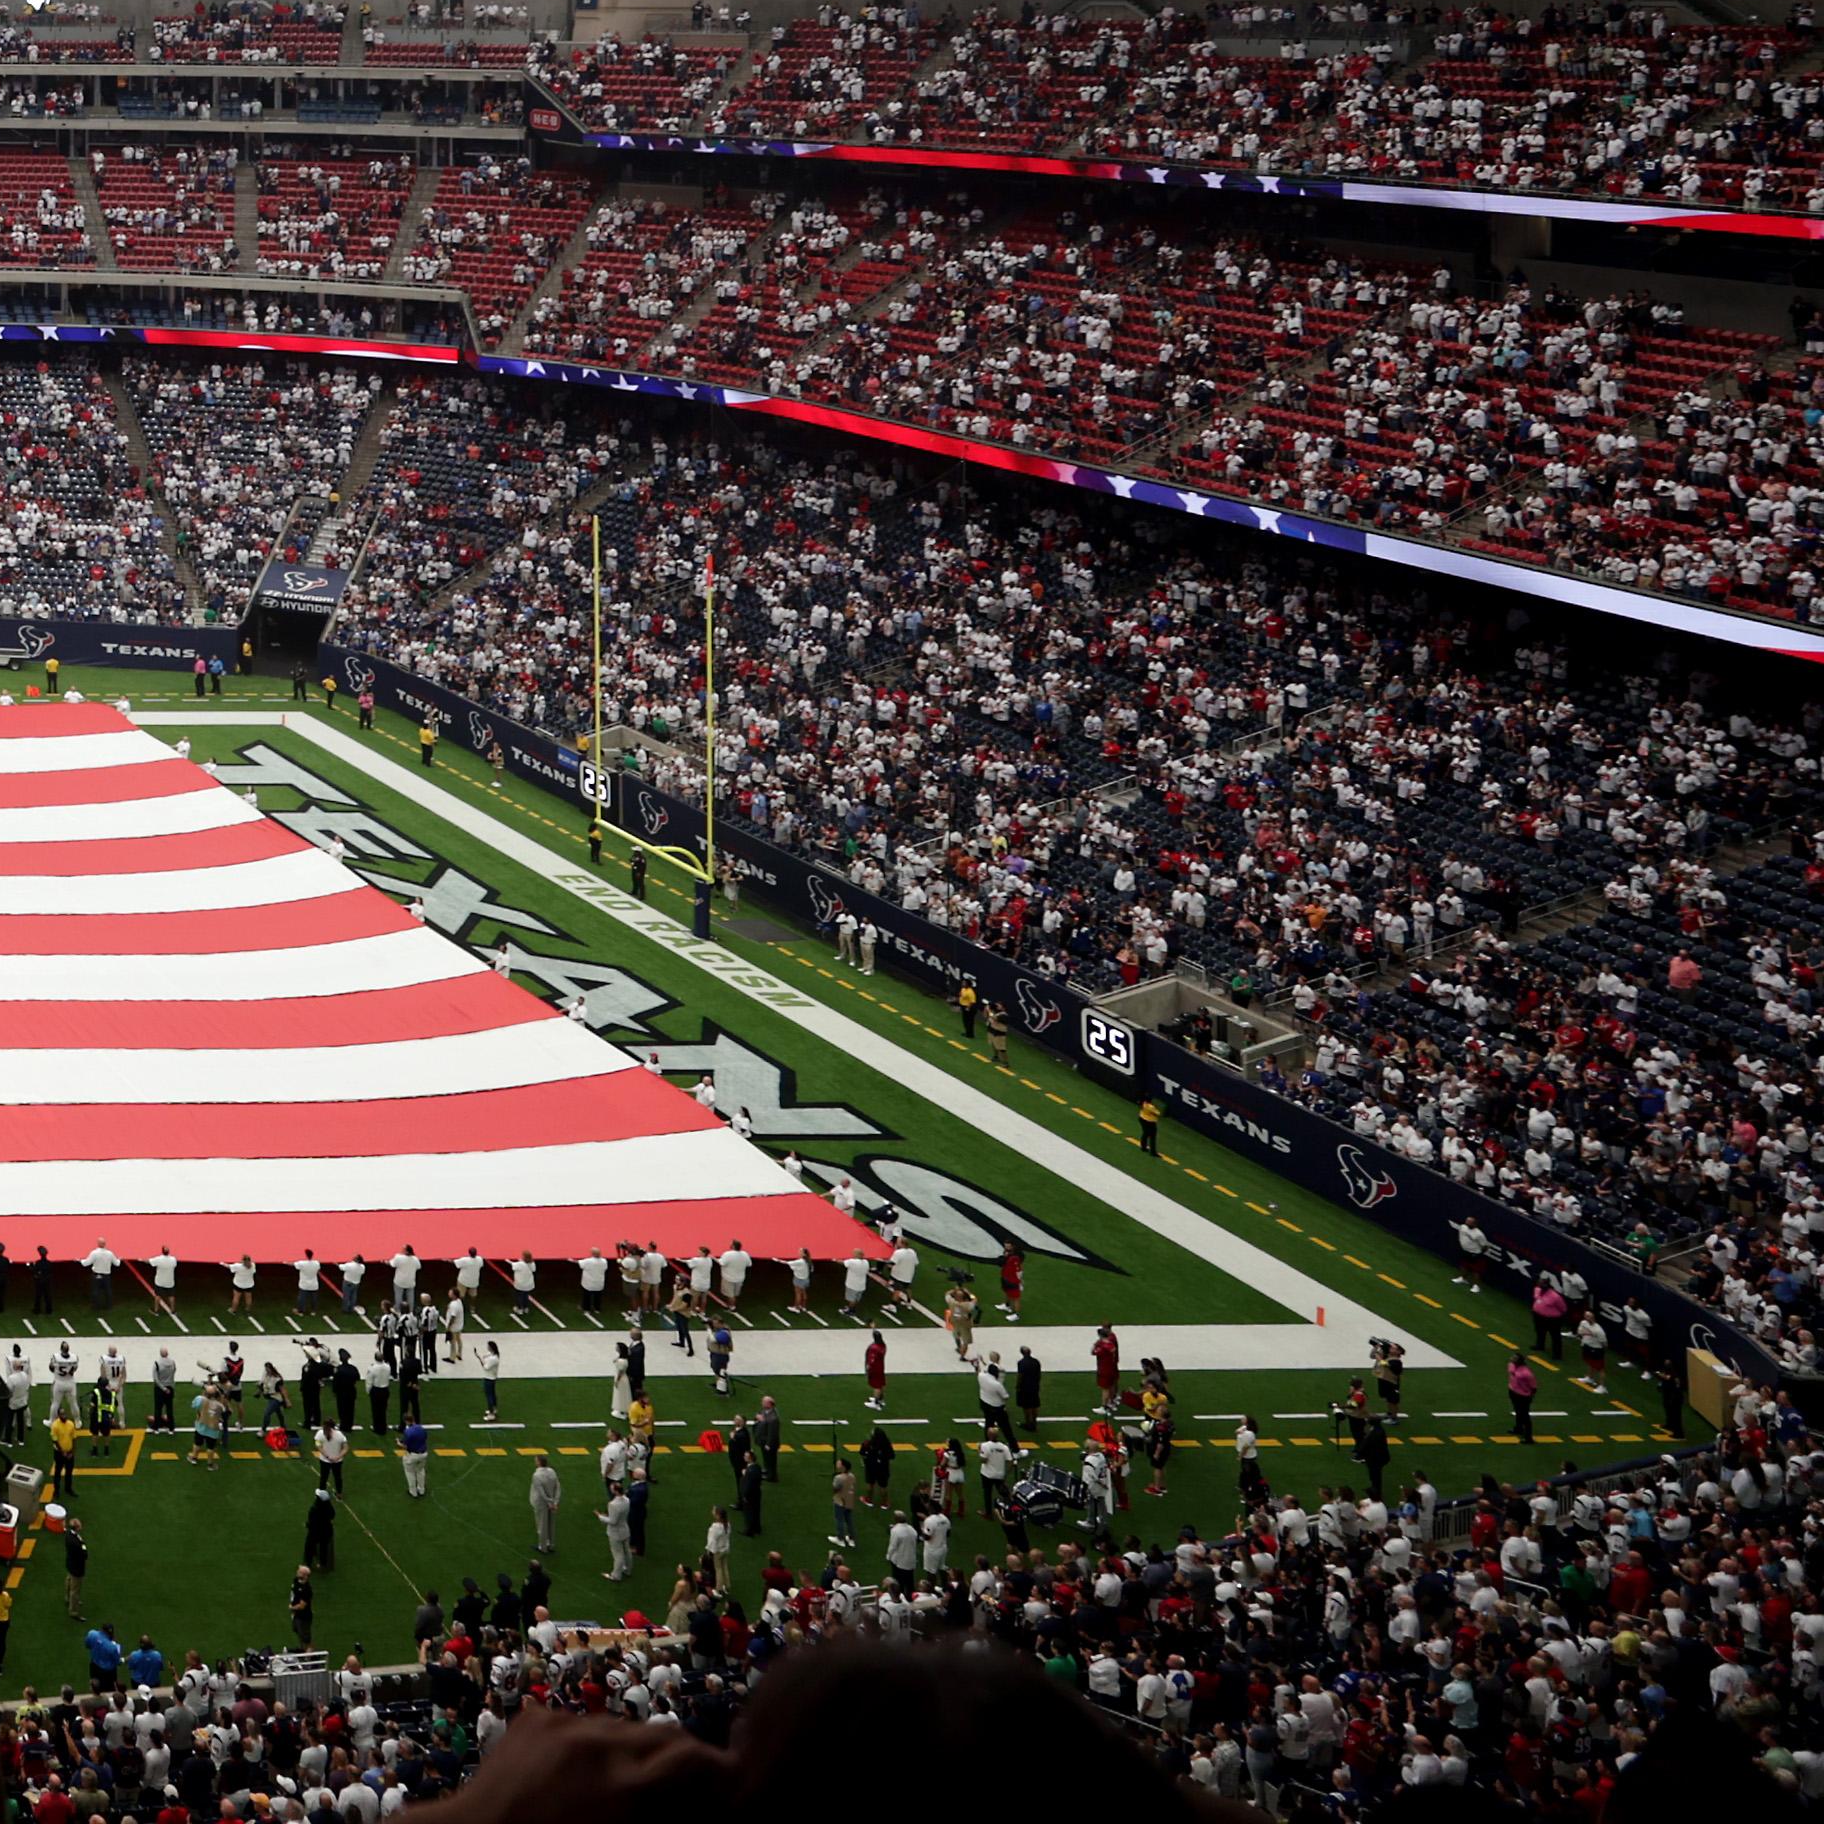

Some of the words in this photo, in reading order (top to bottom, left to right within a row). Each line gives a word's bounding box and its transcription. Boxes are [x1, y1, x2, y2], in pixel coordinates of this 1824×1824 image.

[100, 642, 196, 658] TEXANS
[511, 746, 577, 788] TEXANS
[553, 874, 644, 911] END
[635, 921, 817, 1008] RACISM
[877, 927, 977, 987] TEXANS
[1089, 1019, 1128, 1065] 25
[1157, 1073, 1291, 1154] TEXANS
[58, 1366, 74, 1377] 54
[112, 1366, 120, 1376] 11
[1574, 1739, 1591, 1754] 99
